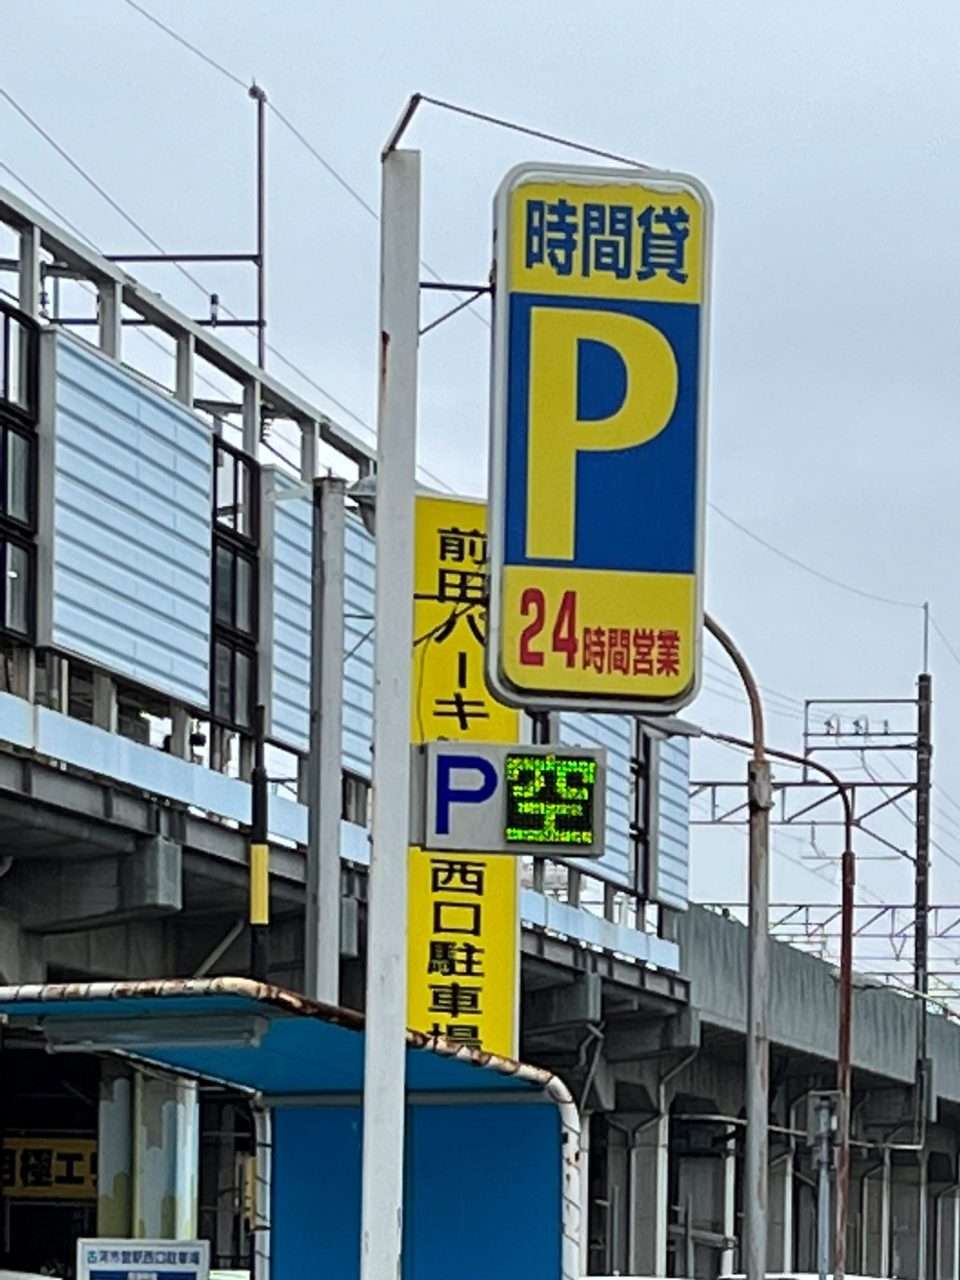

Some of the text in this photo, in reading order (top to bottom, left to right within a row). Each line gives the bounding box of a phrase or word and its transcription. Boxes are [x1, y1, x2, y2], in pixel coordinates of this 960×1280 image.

[524, 199, 690, 284] 時間貸
[525, 306, 679, 560] P
[519, 588, 680, 677] 24時間営業
[435, 755, 498, 834] P
[505, 754, 597, 844] 空
